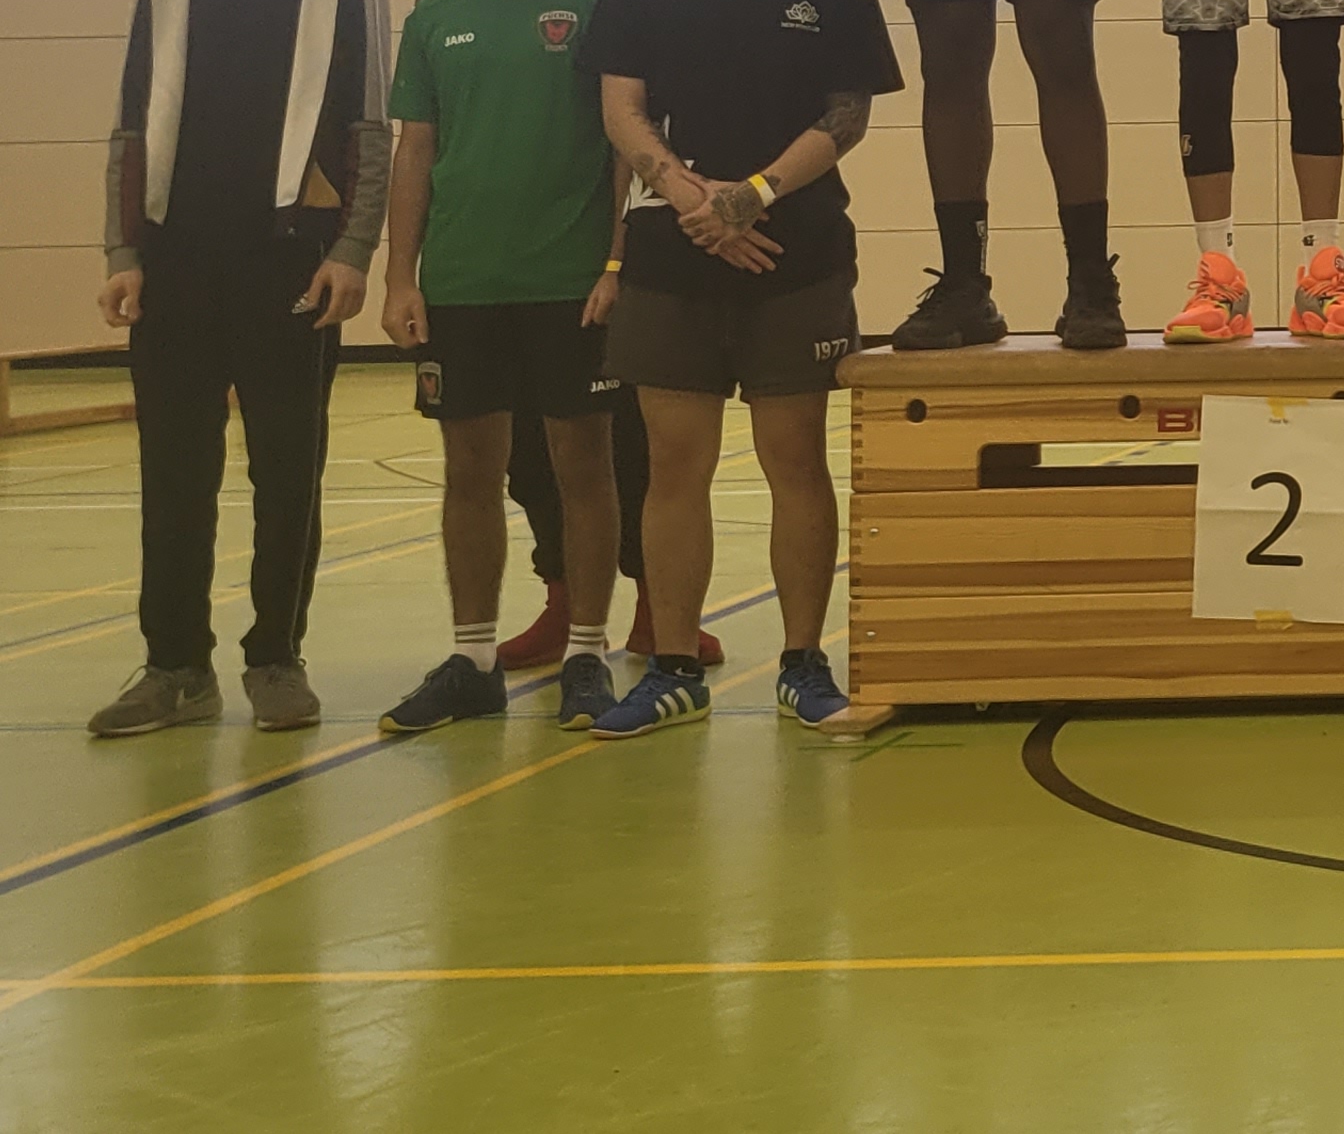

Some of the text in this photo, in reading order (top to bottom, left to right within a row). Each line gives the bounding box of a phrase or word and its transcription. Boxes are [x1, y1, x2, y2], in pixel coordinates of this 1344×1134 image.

[444, 32, 475, 47] JAKO
[814, 338, 849, 361] 1977
[590, 379, 620, 393] JAKO
[1246, 472, 1303, 566] 2
